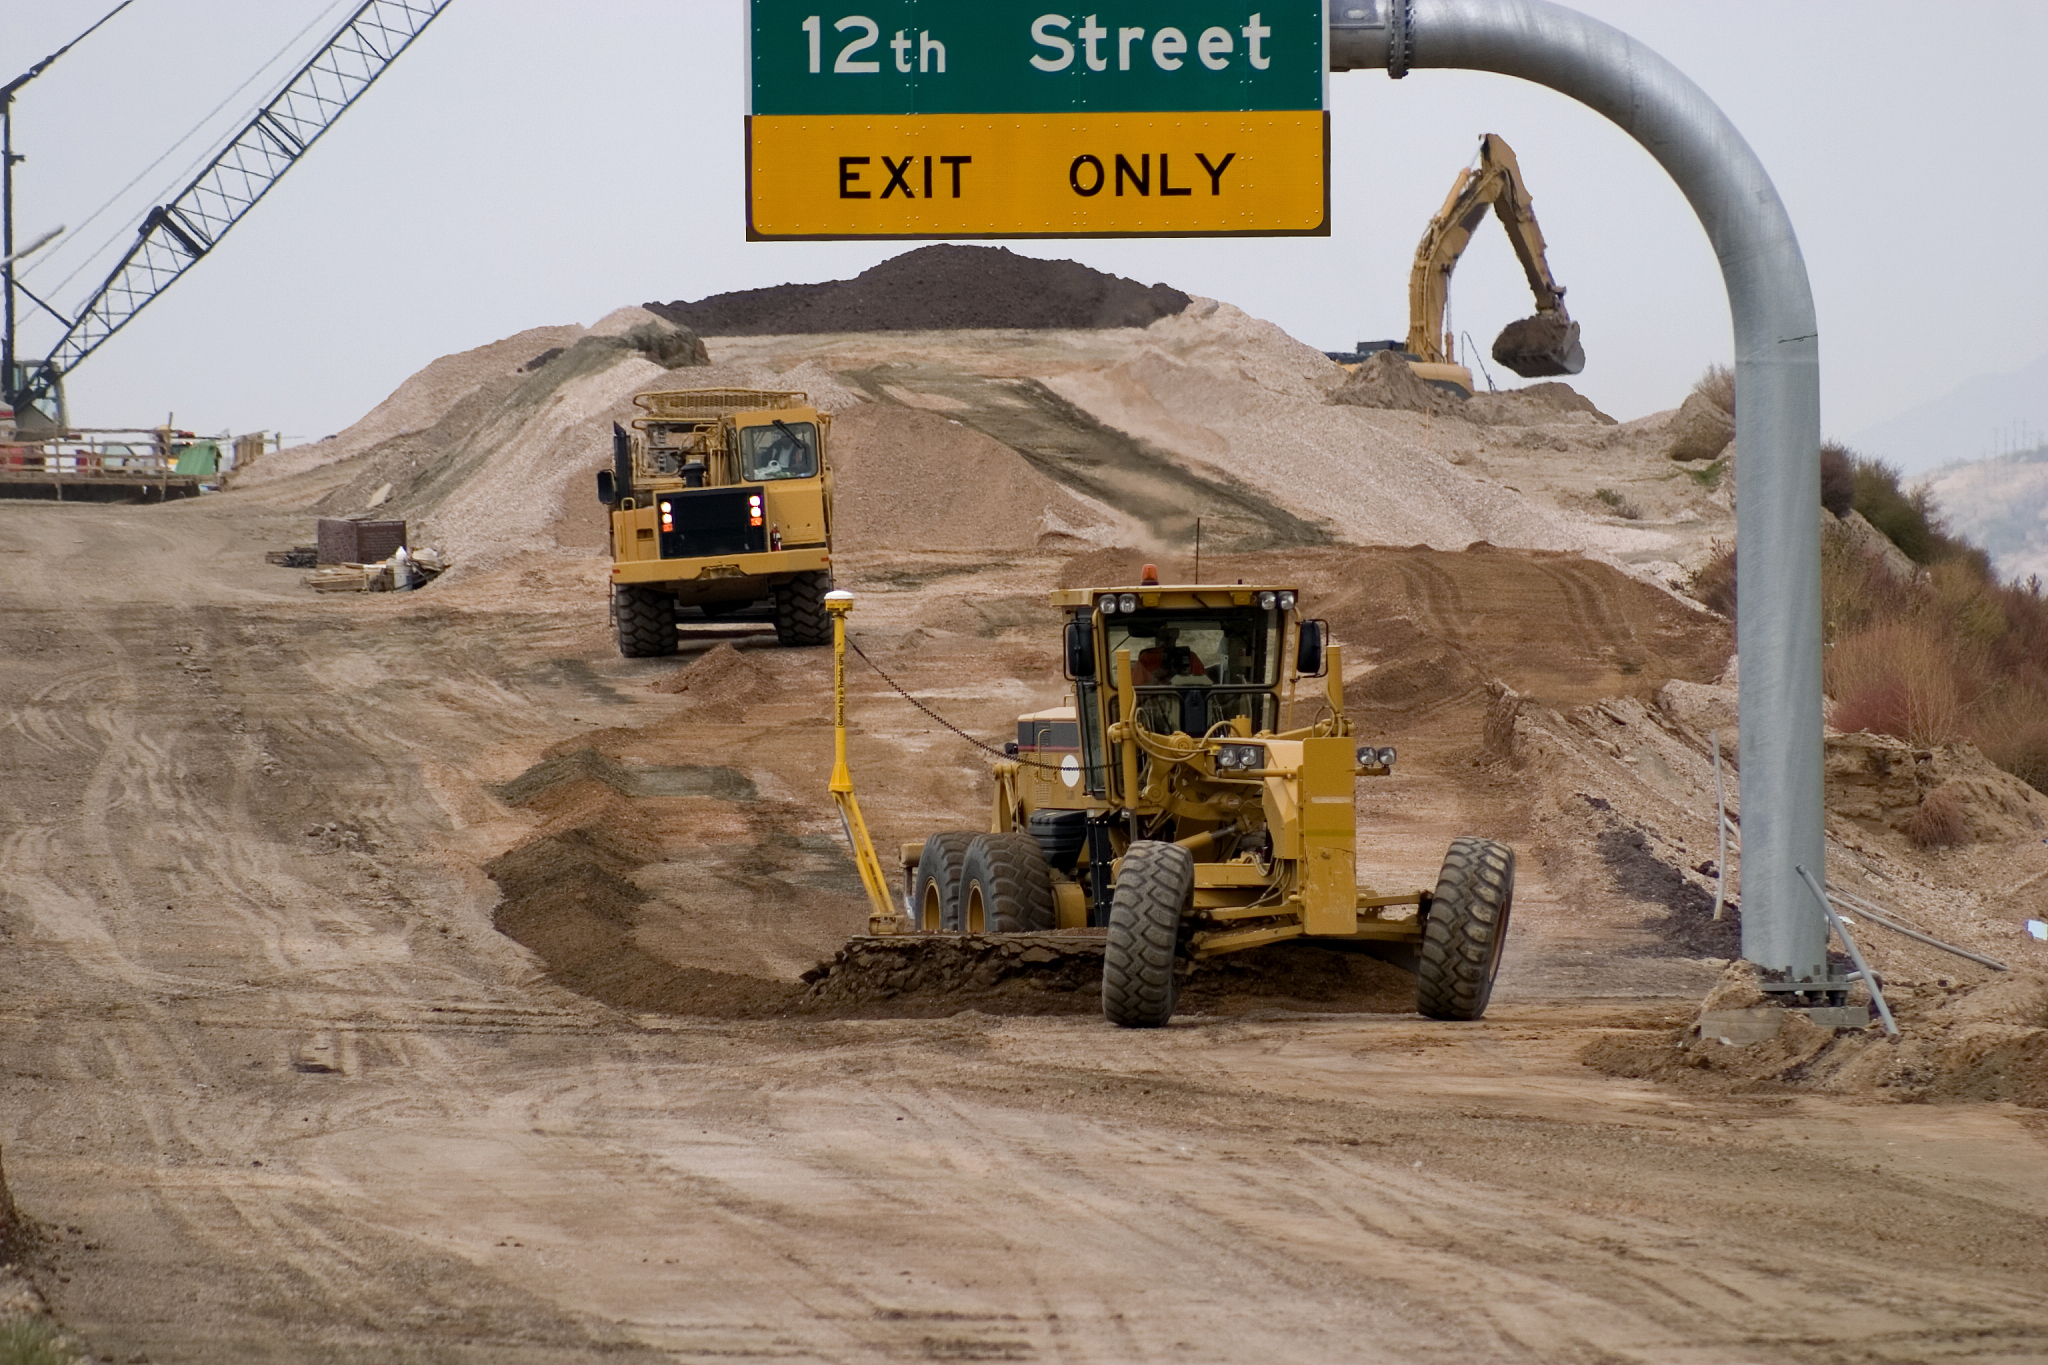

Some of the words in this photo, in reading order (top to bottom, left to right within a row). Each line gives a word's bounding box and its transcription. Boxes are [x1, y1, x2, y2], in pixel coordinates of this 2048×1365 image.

[803, 16, 945, 73] 12th
[1030, 13, 1271, 72] Street
[839, 156, 972, 199] EXIT
[1069, 153, 1236, 197] ONLY
